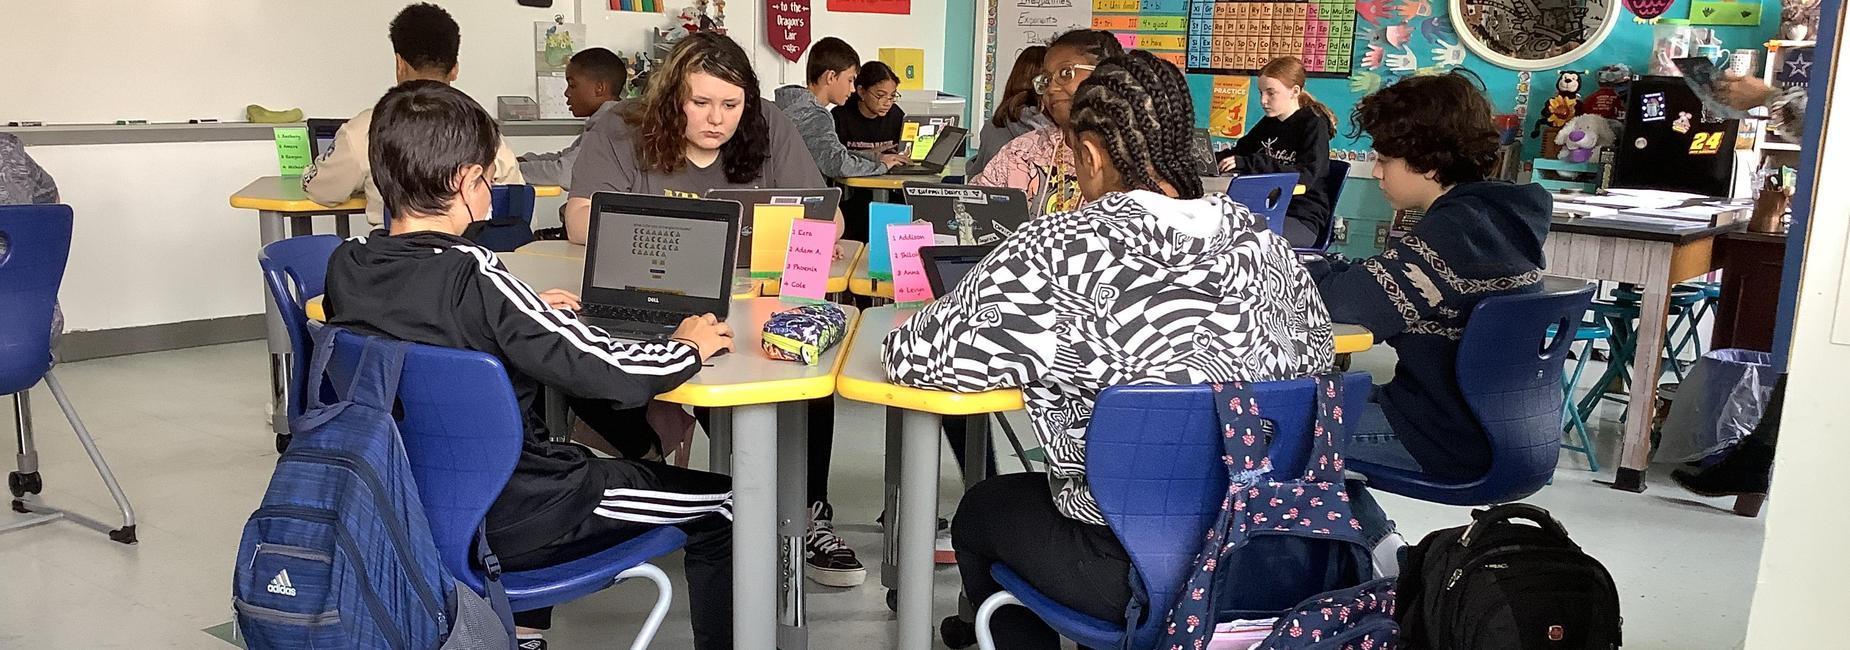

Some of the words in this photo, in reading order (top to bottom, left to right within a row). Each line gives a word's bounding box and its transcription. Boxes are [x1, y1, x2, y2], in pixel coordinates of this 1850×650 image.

[780, 2, 787, 11] to
[790, 1, 801, 12] the
[777, 15, 804, 29] Dragon's
[784, 29, 797, 40] Lair
[1690, 132, 1724, 150] 24
[795, 246, 813, 254] Adam
[793, 264, 817, 273] Phoenix
[791, 281, 806, 289] Cole
[267, 584, 297, 597] adidas
